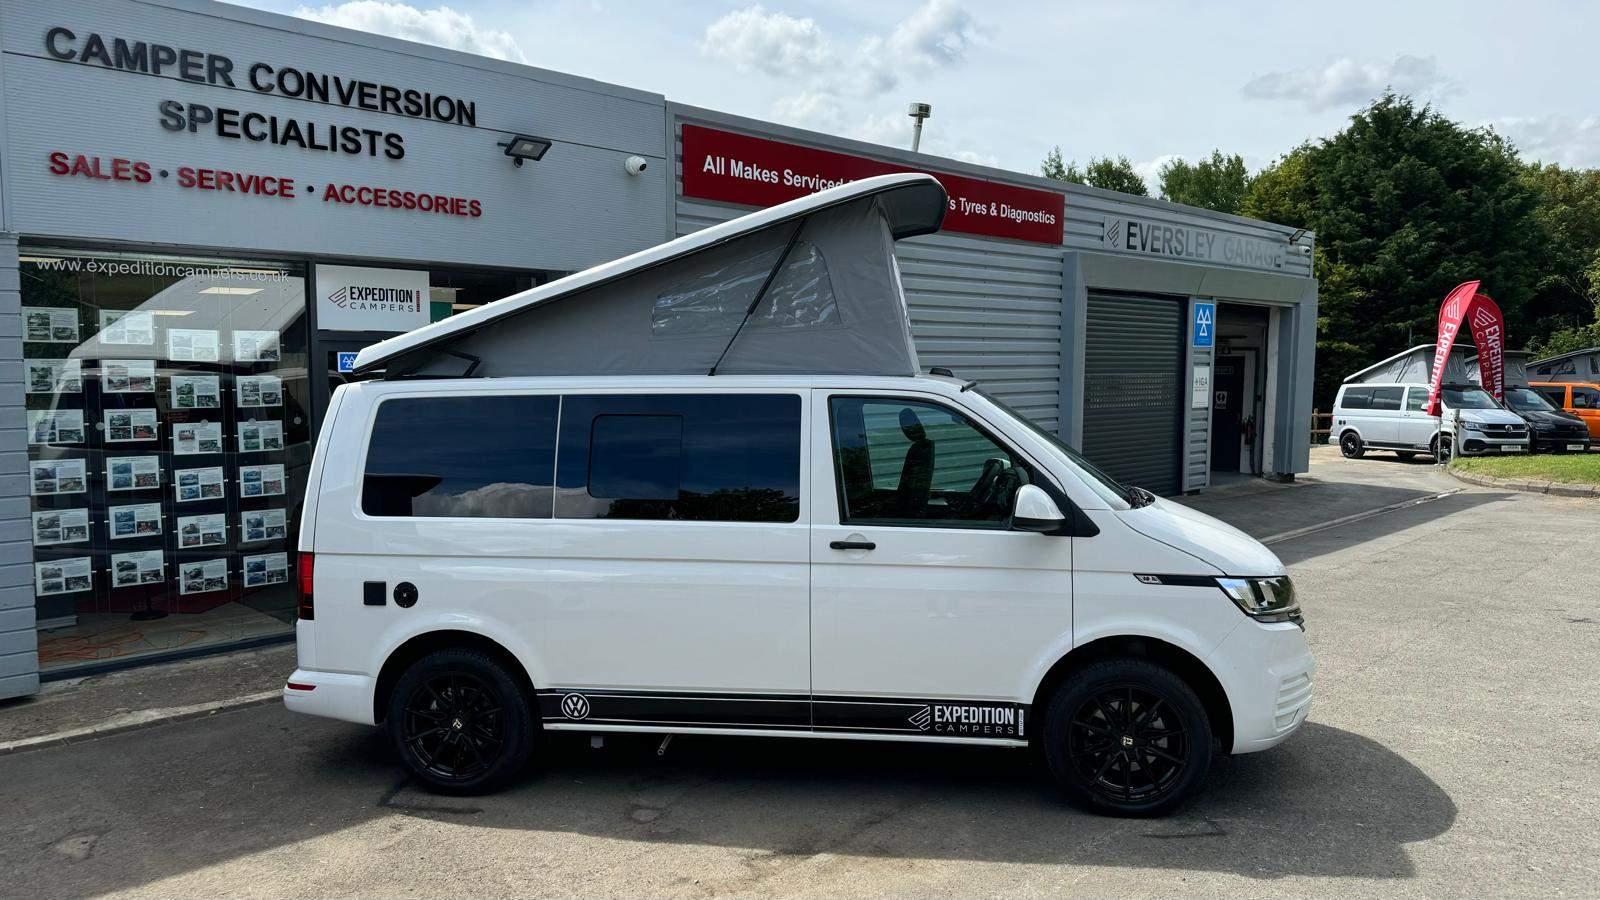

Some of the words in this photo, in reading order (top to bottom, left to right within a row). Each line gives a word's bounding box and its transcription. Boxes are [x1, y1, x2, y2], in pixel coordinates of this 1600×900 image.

[46, 26, 236, 87] CAMPER
[249, 62, 476, 127] CONVERSION
[159, 99, 405, 160] SPECIALISTS
[50, 151, 152, 183] SALES
[177, 166, 295, 199] SERVICE
[323, 183, 482, 218] ACCESSORIES
[703, 155, 725, 176] All
[730, 158, 779, 184] Makes
[959, 197, 987, 216] Tyres
[989, 202, 998, 217] &
[1000, 203, 1056, 225] Diagnostics
[36, 257, 289, 283] www.expeditioncampers.co.uk
[1126, 221, 1216, 260] EVERSLEY
[1223, 236, 1282, 269] GARAGE
[349, 286, 413, 303] EXPEDITION
[350, 302, 414, 313] CAMPERS
[1428, 322, 1456, 396] EXPEDITION
[1485, 325, 1502, 394] EXPEDITION
[934, 705, 1014, 725] EXPEDITION
[935, 723, 1014, 734] CAMPERS
